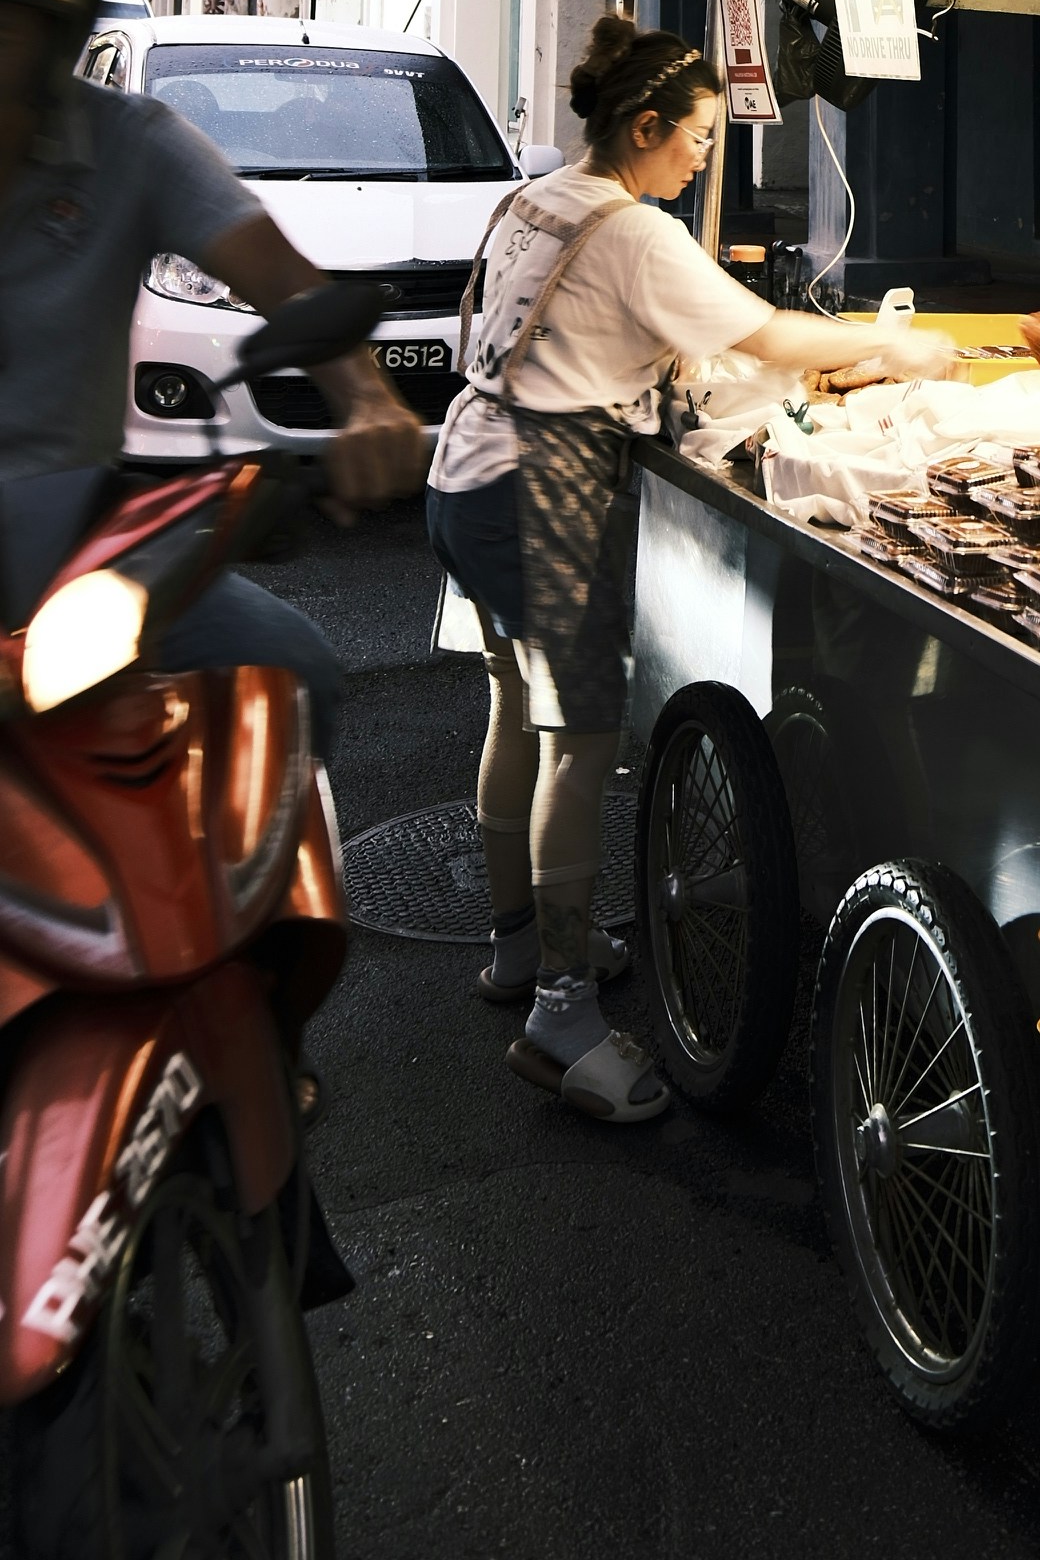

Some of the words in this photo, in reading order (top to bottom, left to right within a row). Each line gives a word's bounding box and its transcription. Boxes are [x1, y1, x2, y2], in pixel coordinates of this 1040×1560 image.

[847, 37, 859, 57] NO
[860, 37, 886, 59] DRIVE
[887, 37, 911, 60] THRU
